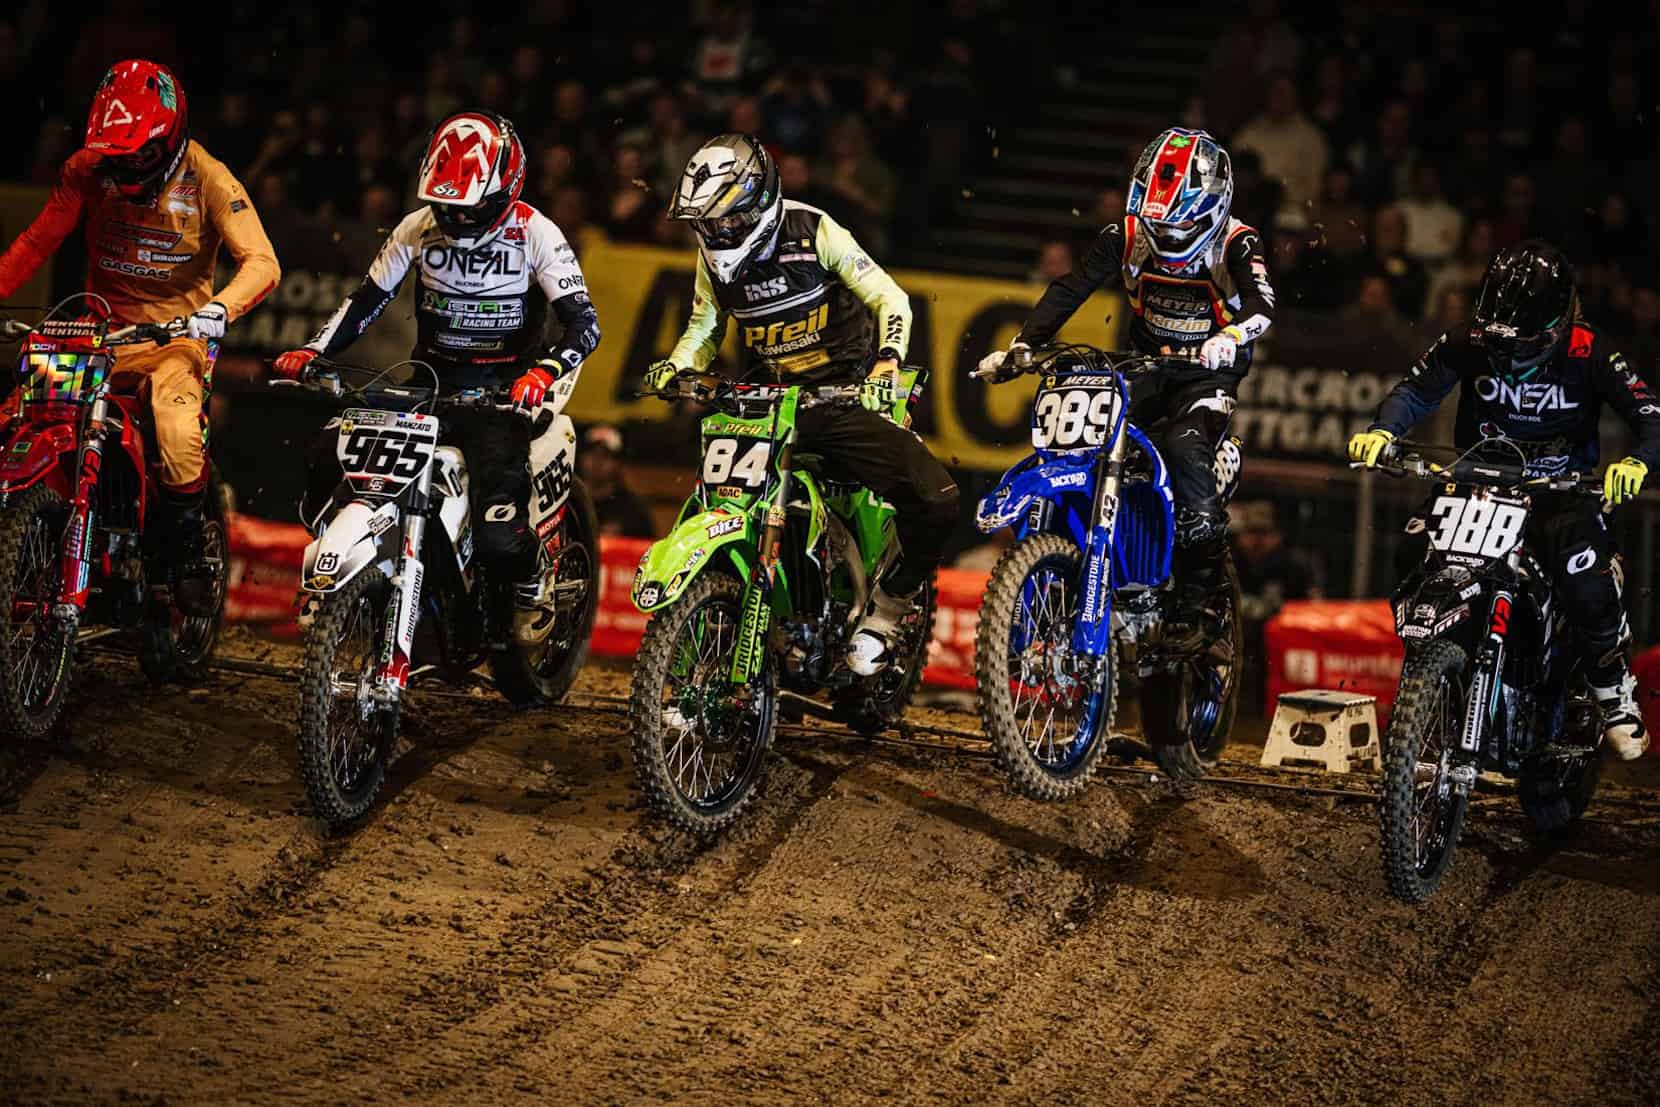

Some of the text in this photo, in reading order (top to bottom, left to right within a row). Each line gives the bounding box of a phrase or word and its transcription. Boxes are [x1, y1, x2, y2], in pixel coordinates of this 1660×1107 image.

[100, 257, 171, 280] GASGAS
[42, 327, 97, 336] RENTHAL
[462, 317, 521, 327] RACING TEAM
[1063, 375, 1113, 386] MEYER
[1032, 389, 1123, 450] 389
[343, 427, 434, 478] 965
[703, 438, 772, 488] 84
[1427, 495, 1528, 559] 388
[1081, 554, 1101, 623] BRIDGESTONE
